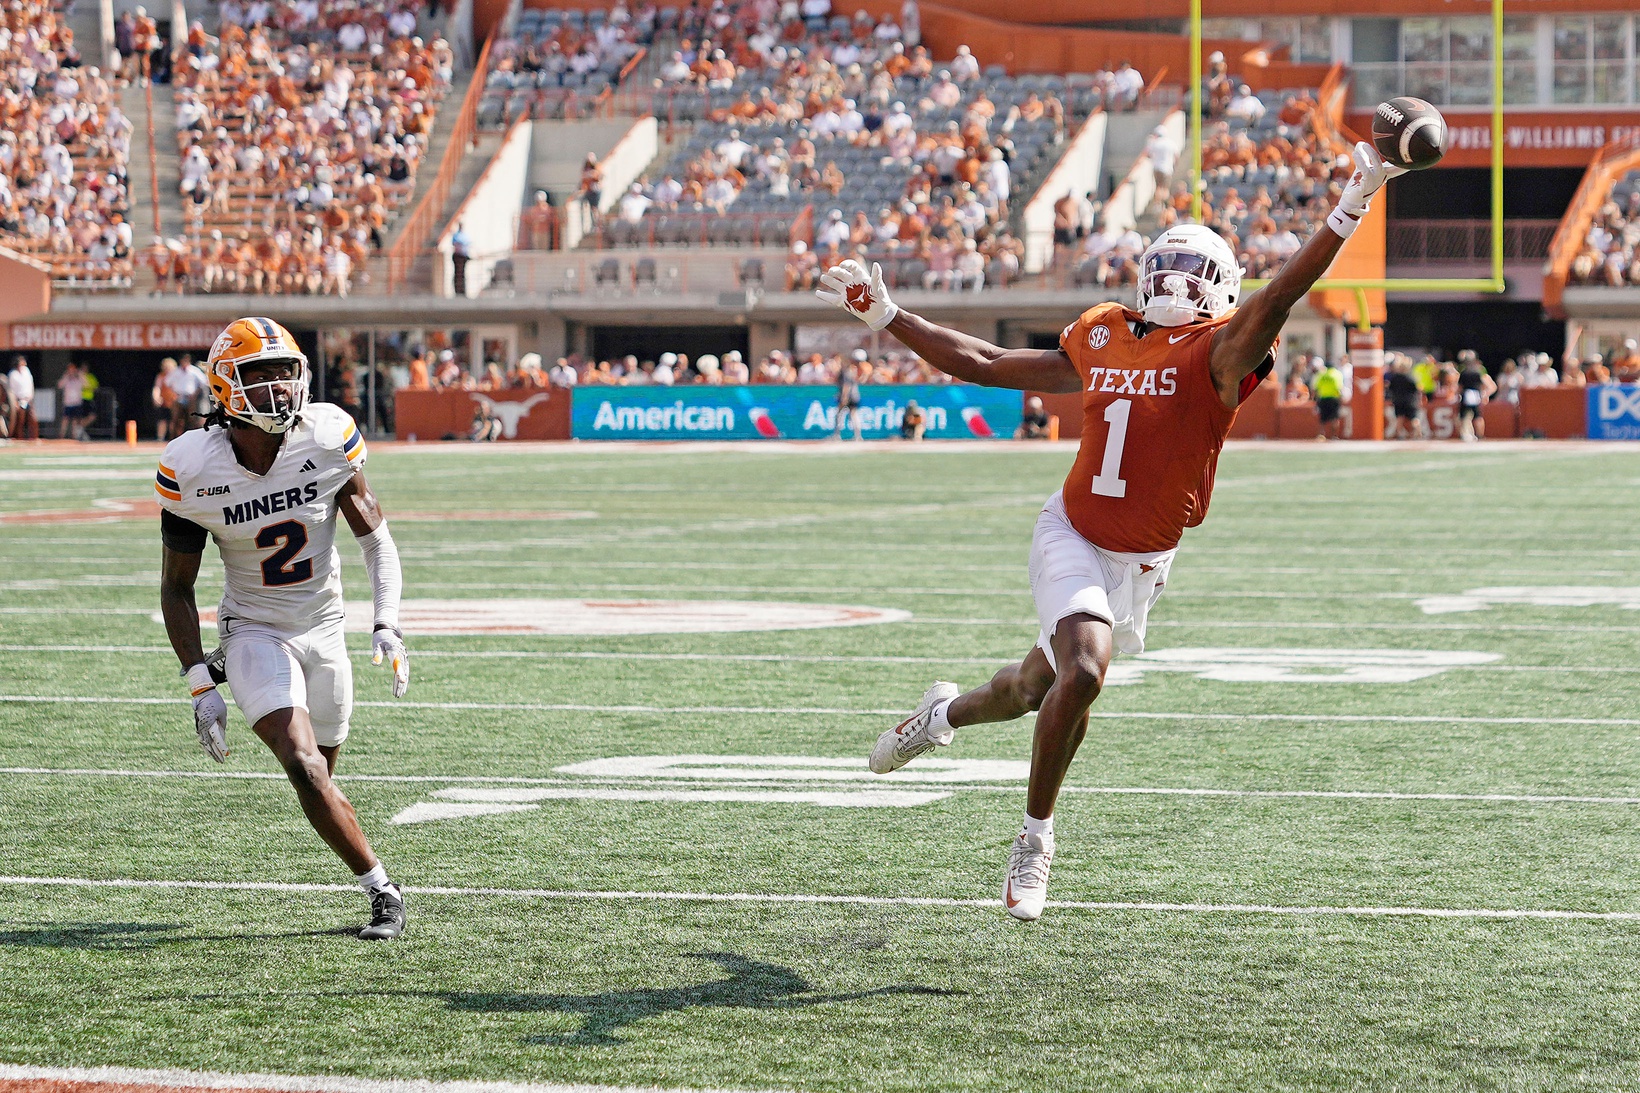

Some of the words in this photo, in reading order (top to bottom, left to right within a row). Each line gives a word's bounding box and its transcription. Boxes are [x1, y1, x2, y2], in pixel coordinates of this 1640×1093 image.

[13, 325, 95, 347] SMOKEY
[102, 325, 142, 347] THE
[149, 325, 223, 347] CANNO
[1090, 327, 1109, 348] SEC
[1087, 367, 1177, 396] TEXAS
[593, 400, 735, 430] American
[1091, 398, 1132, 498] 1
[223, 481, 318, 525] MINERS
[254, 518, 313, 587] 2
